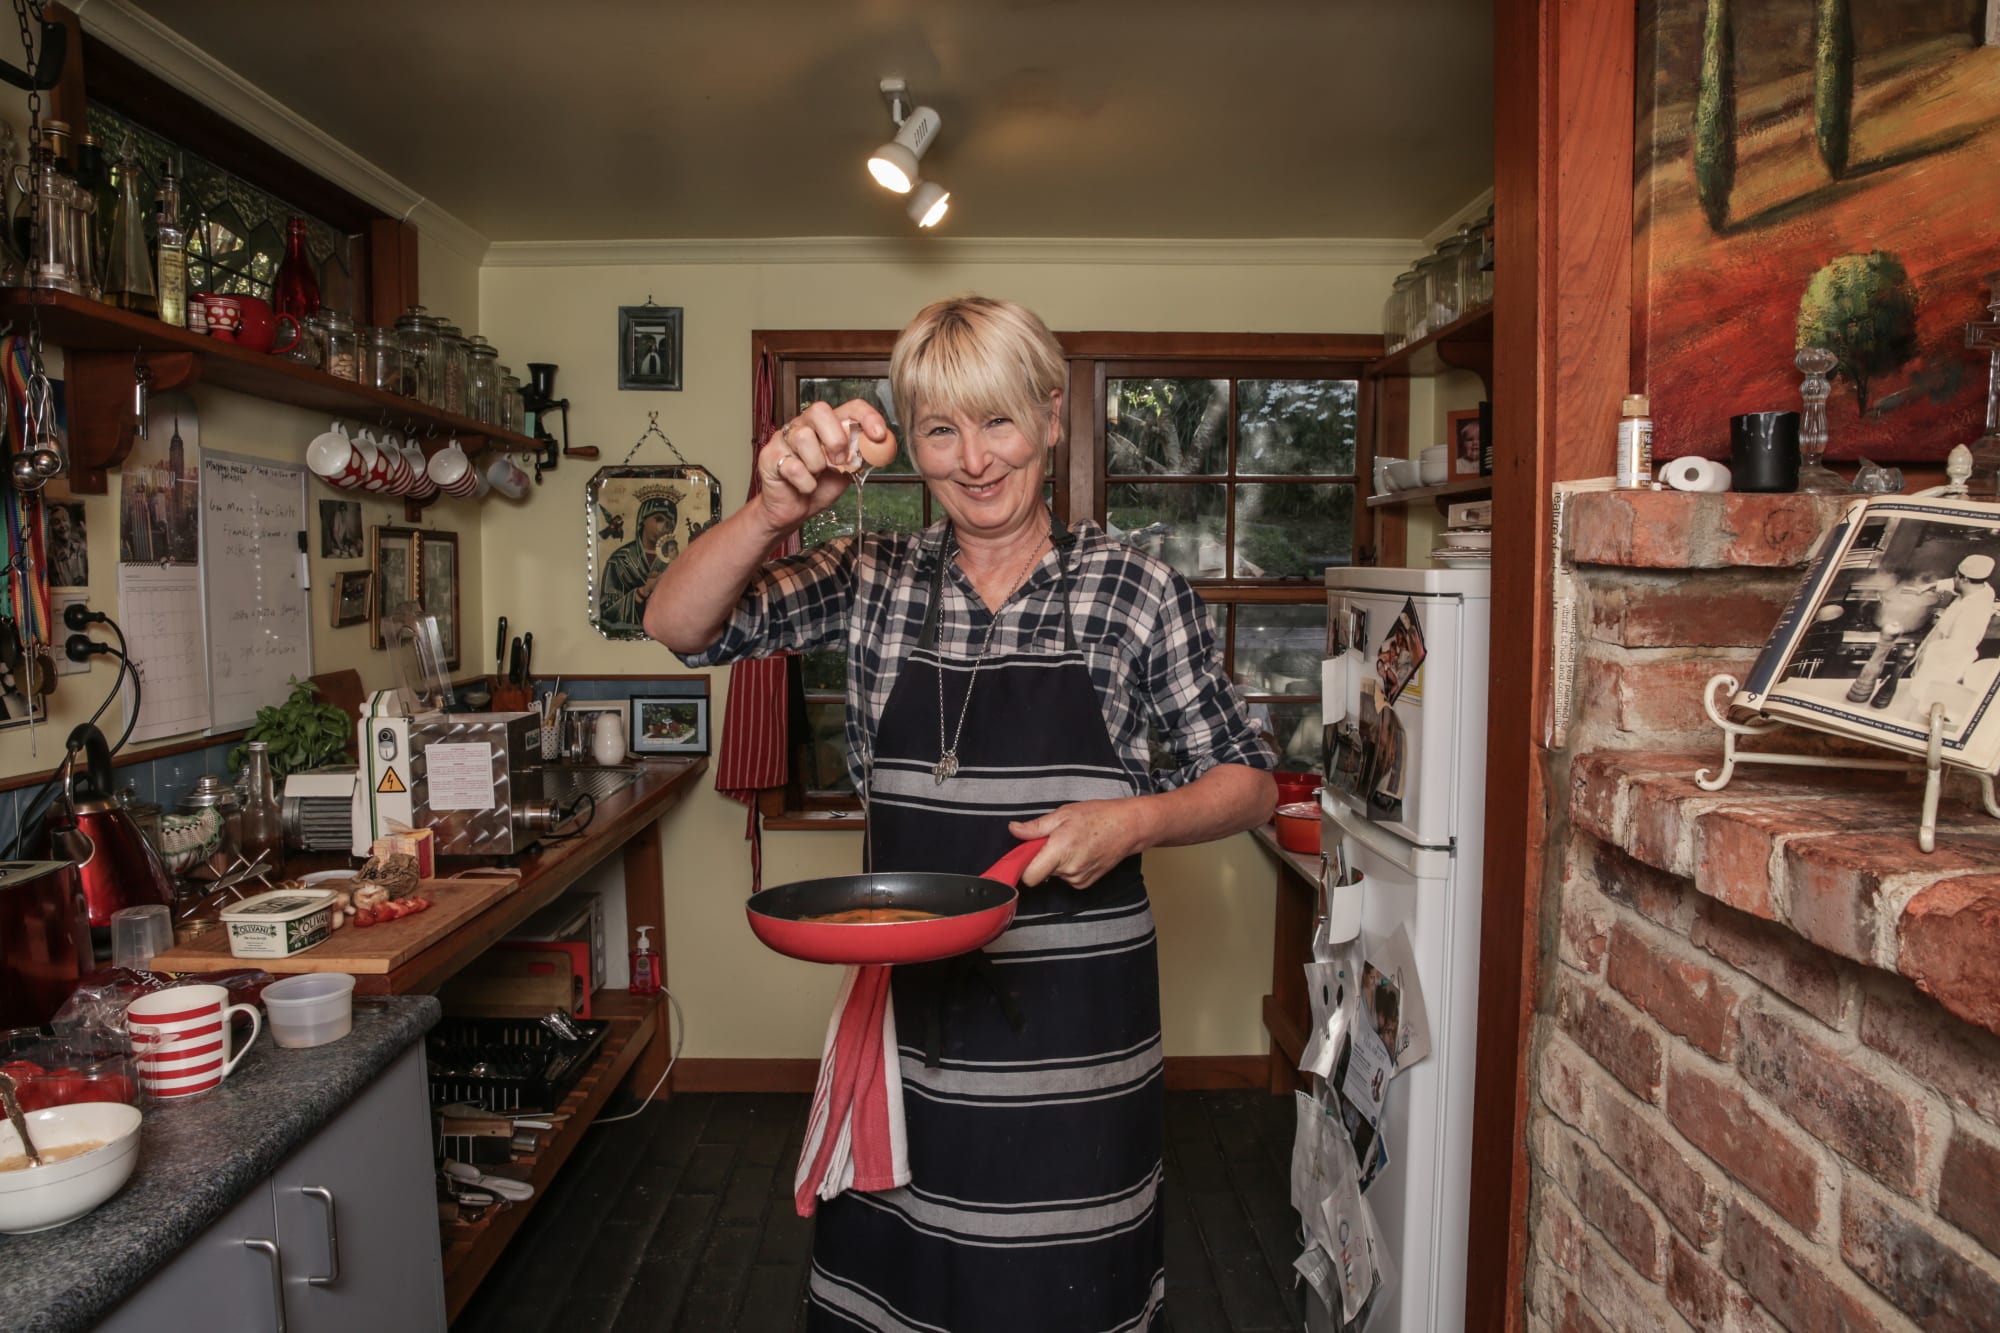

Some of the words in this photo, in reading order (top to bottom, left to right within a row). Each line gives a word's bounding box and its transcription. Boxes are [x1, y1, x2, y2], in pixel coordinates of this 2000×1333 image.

[1561, 604, 1569, 633] vibrant
[1559, 634, 1568, 662] school
[1565, 664, 1573, 682] year
[1554, 681, 1564, 727] community
[1562, 684, 1571, 718] planned
[239, 925, 269, 935] OLIVANI
